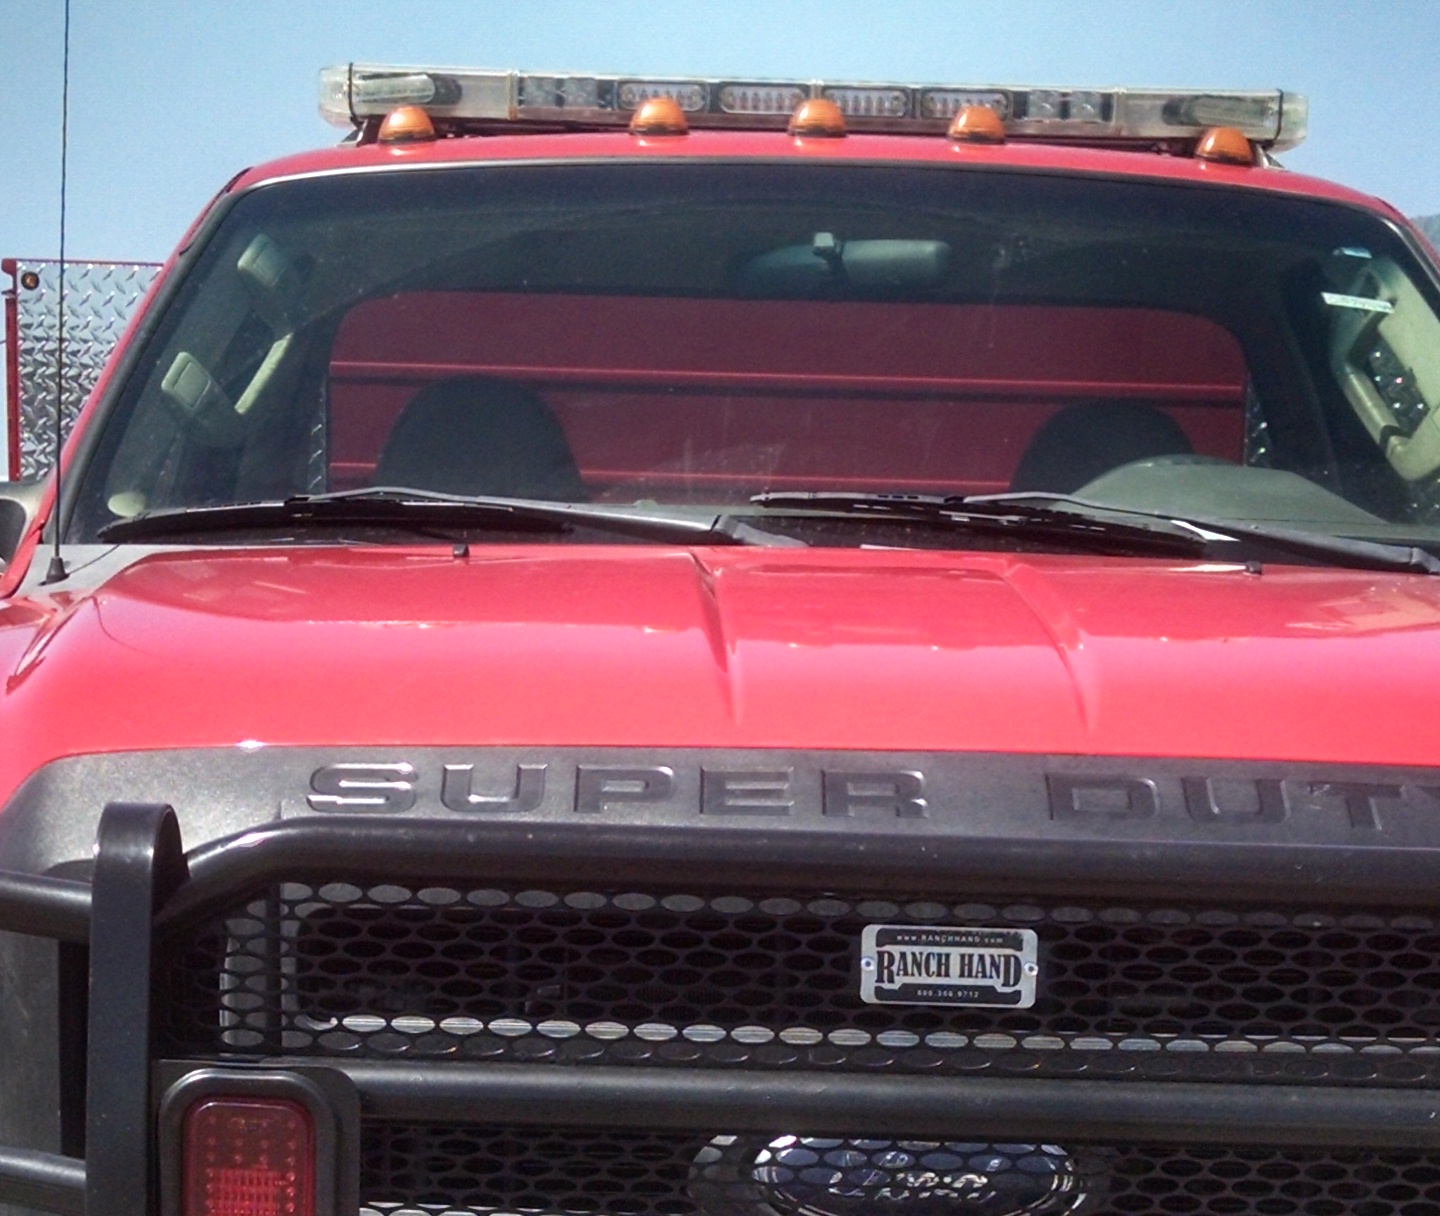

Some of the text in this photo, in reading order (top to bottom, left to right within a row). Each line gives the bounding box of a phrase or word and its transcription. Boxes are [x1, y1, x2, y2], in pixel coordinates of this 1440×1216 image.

[306, 761, 930, 818] SUPER
[874, 950, 1022, 988] RANCH HAND
